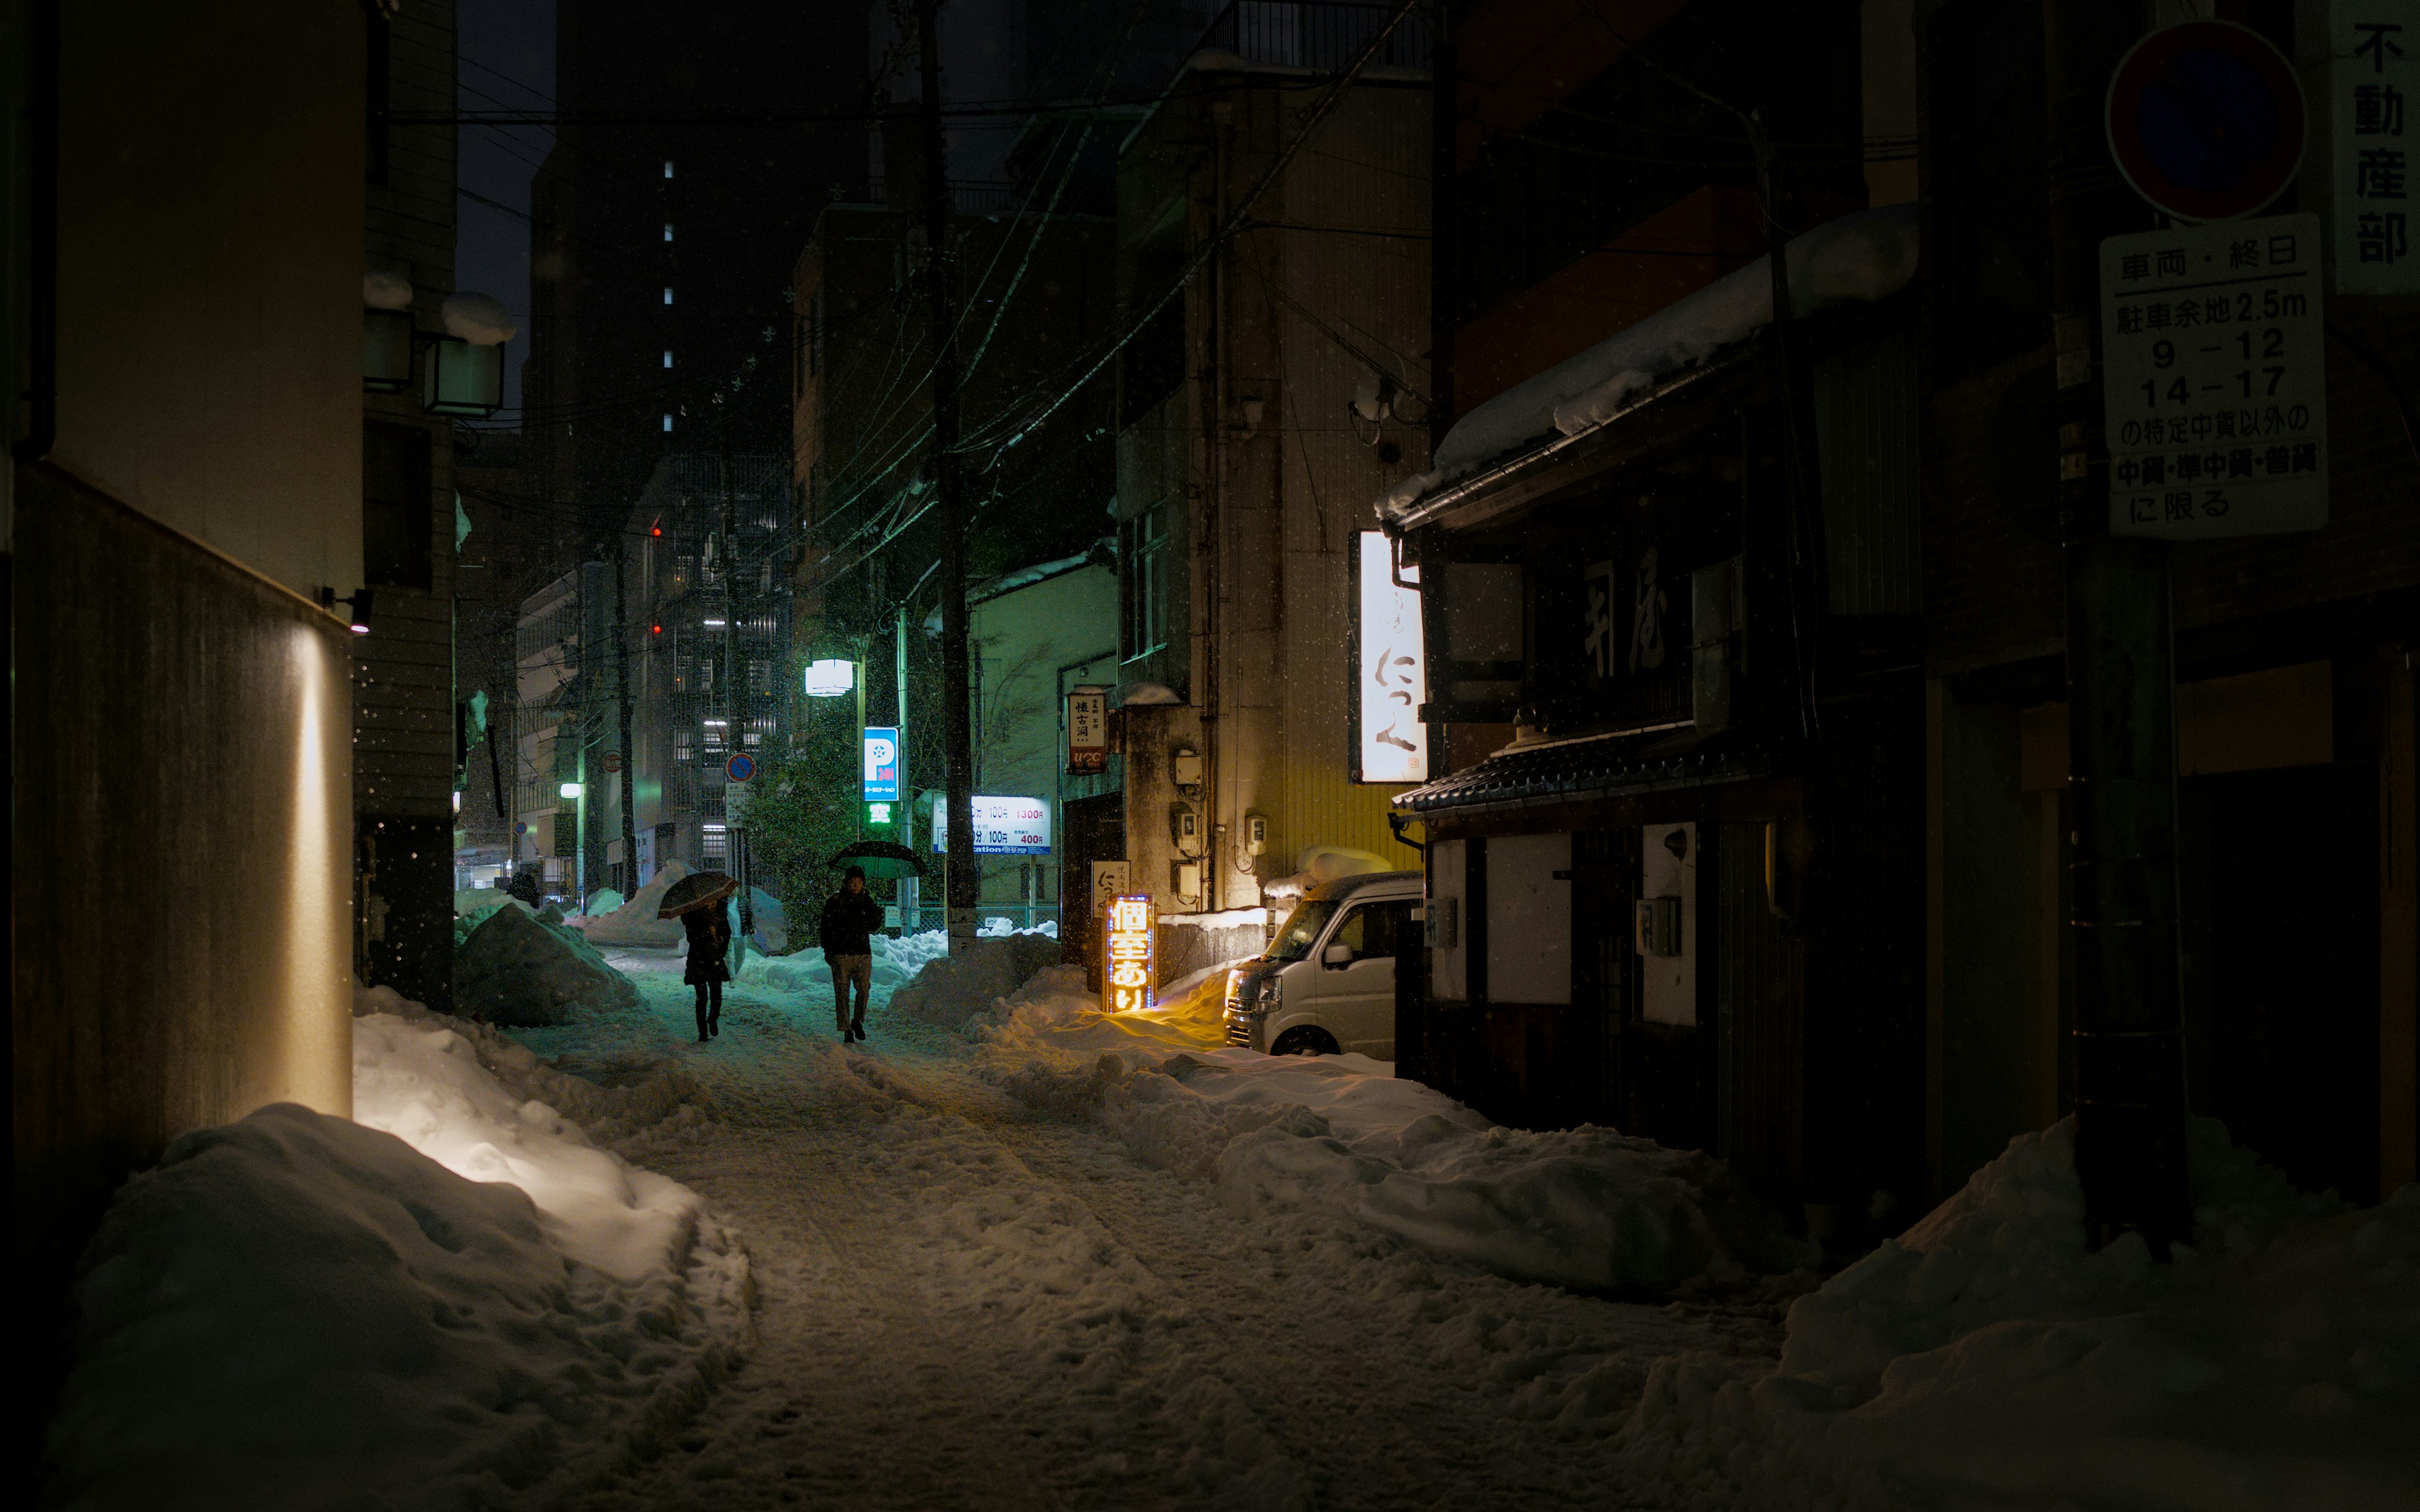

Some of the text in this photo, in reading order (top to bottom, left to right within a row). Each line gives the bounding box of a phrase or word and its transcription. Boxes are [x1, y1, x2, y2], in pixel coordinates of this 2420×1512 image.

[2354, 23, 2407, 263] 不動産部
[2120, 234, 2296, 282] 車両・終日
[2117, 289, 2307, 335] 駐車余地2.5m
[2121, 404, 2309, 447] の特定中貨以外の
[2117, 442, 2317, 488] 中貨・準中貨・普貨
[2131, 490, 2229, 524] に限る
[878, 768, 894, 781] 24H
[1017, 810, 1043, 819] 1300円
[1021, 835, 1043, 844] 400円
[1112, 901, 1148, 1011] 個室あり
